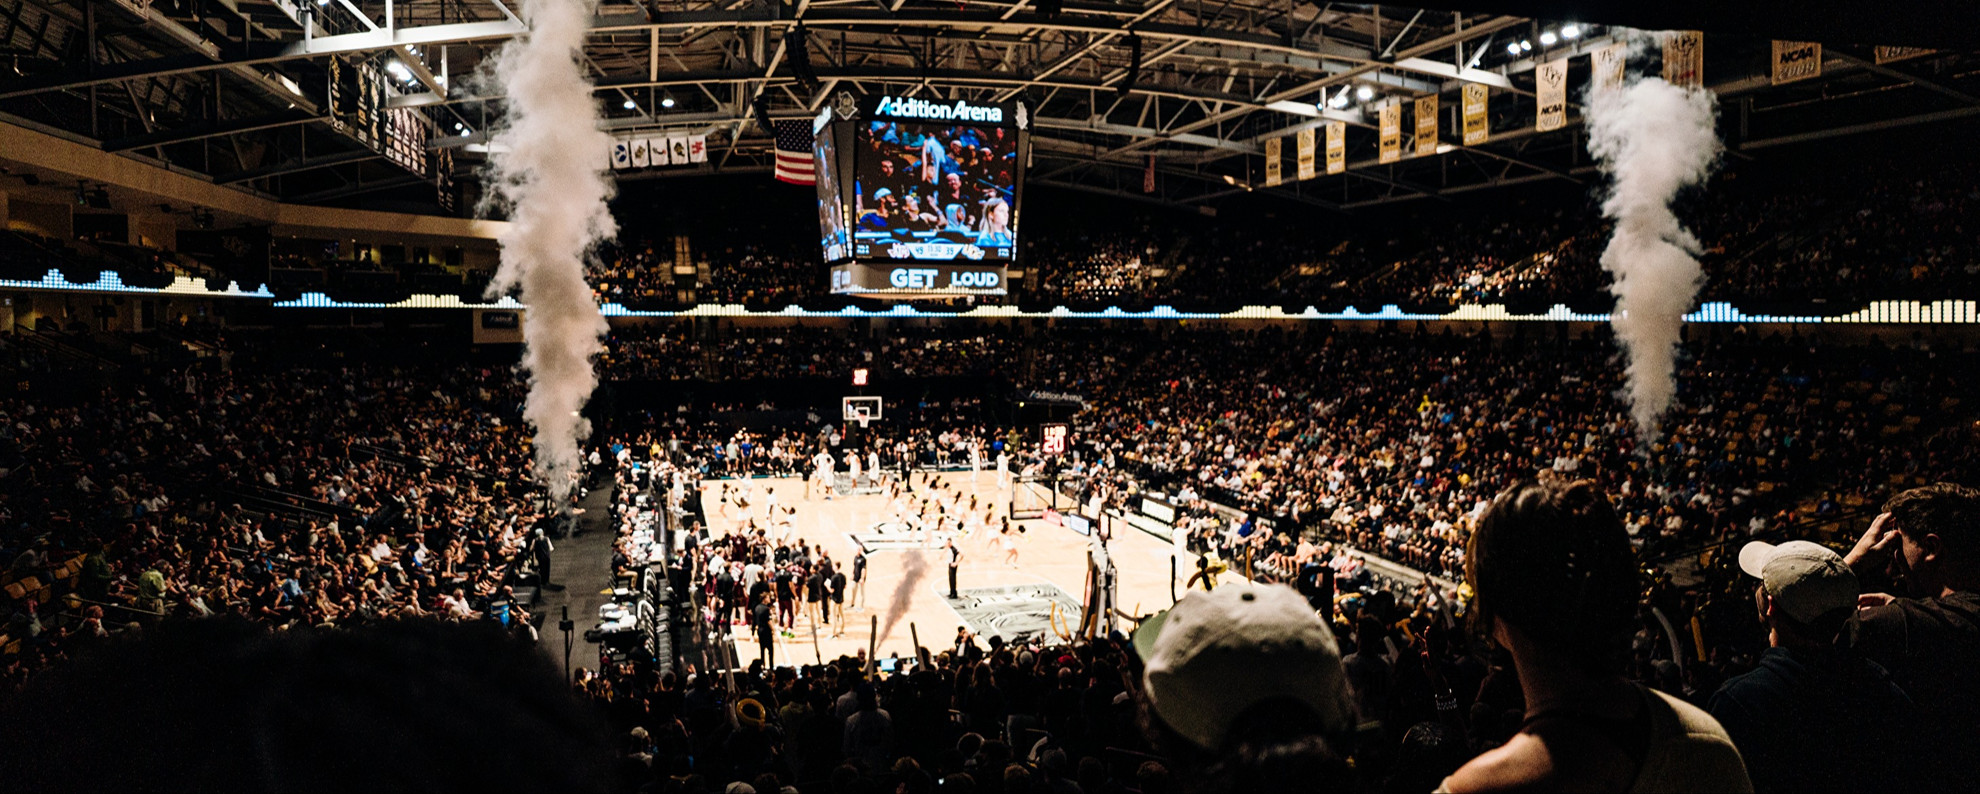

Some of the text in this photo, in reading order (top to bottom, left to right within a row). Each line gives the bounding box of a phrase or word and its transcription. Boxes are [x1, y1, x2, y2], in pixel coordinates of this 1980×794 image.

[1780, 47, 1814, 63] NCAA
[875, 96, 1003, 122] Addition Arena
[1540, 103, 1563, 116] NCAA
[890, 268, 938, 288] GET
[951, 272, 999, 287] LOUD
[1030, 390, 1083, 402] Addition Arena
[1044, 436, 1065, 452] 20
